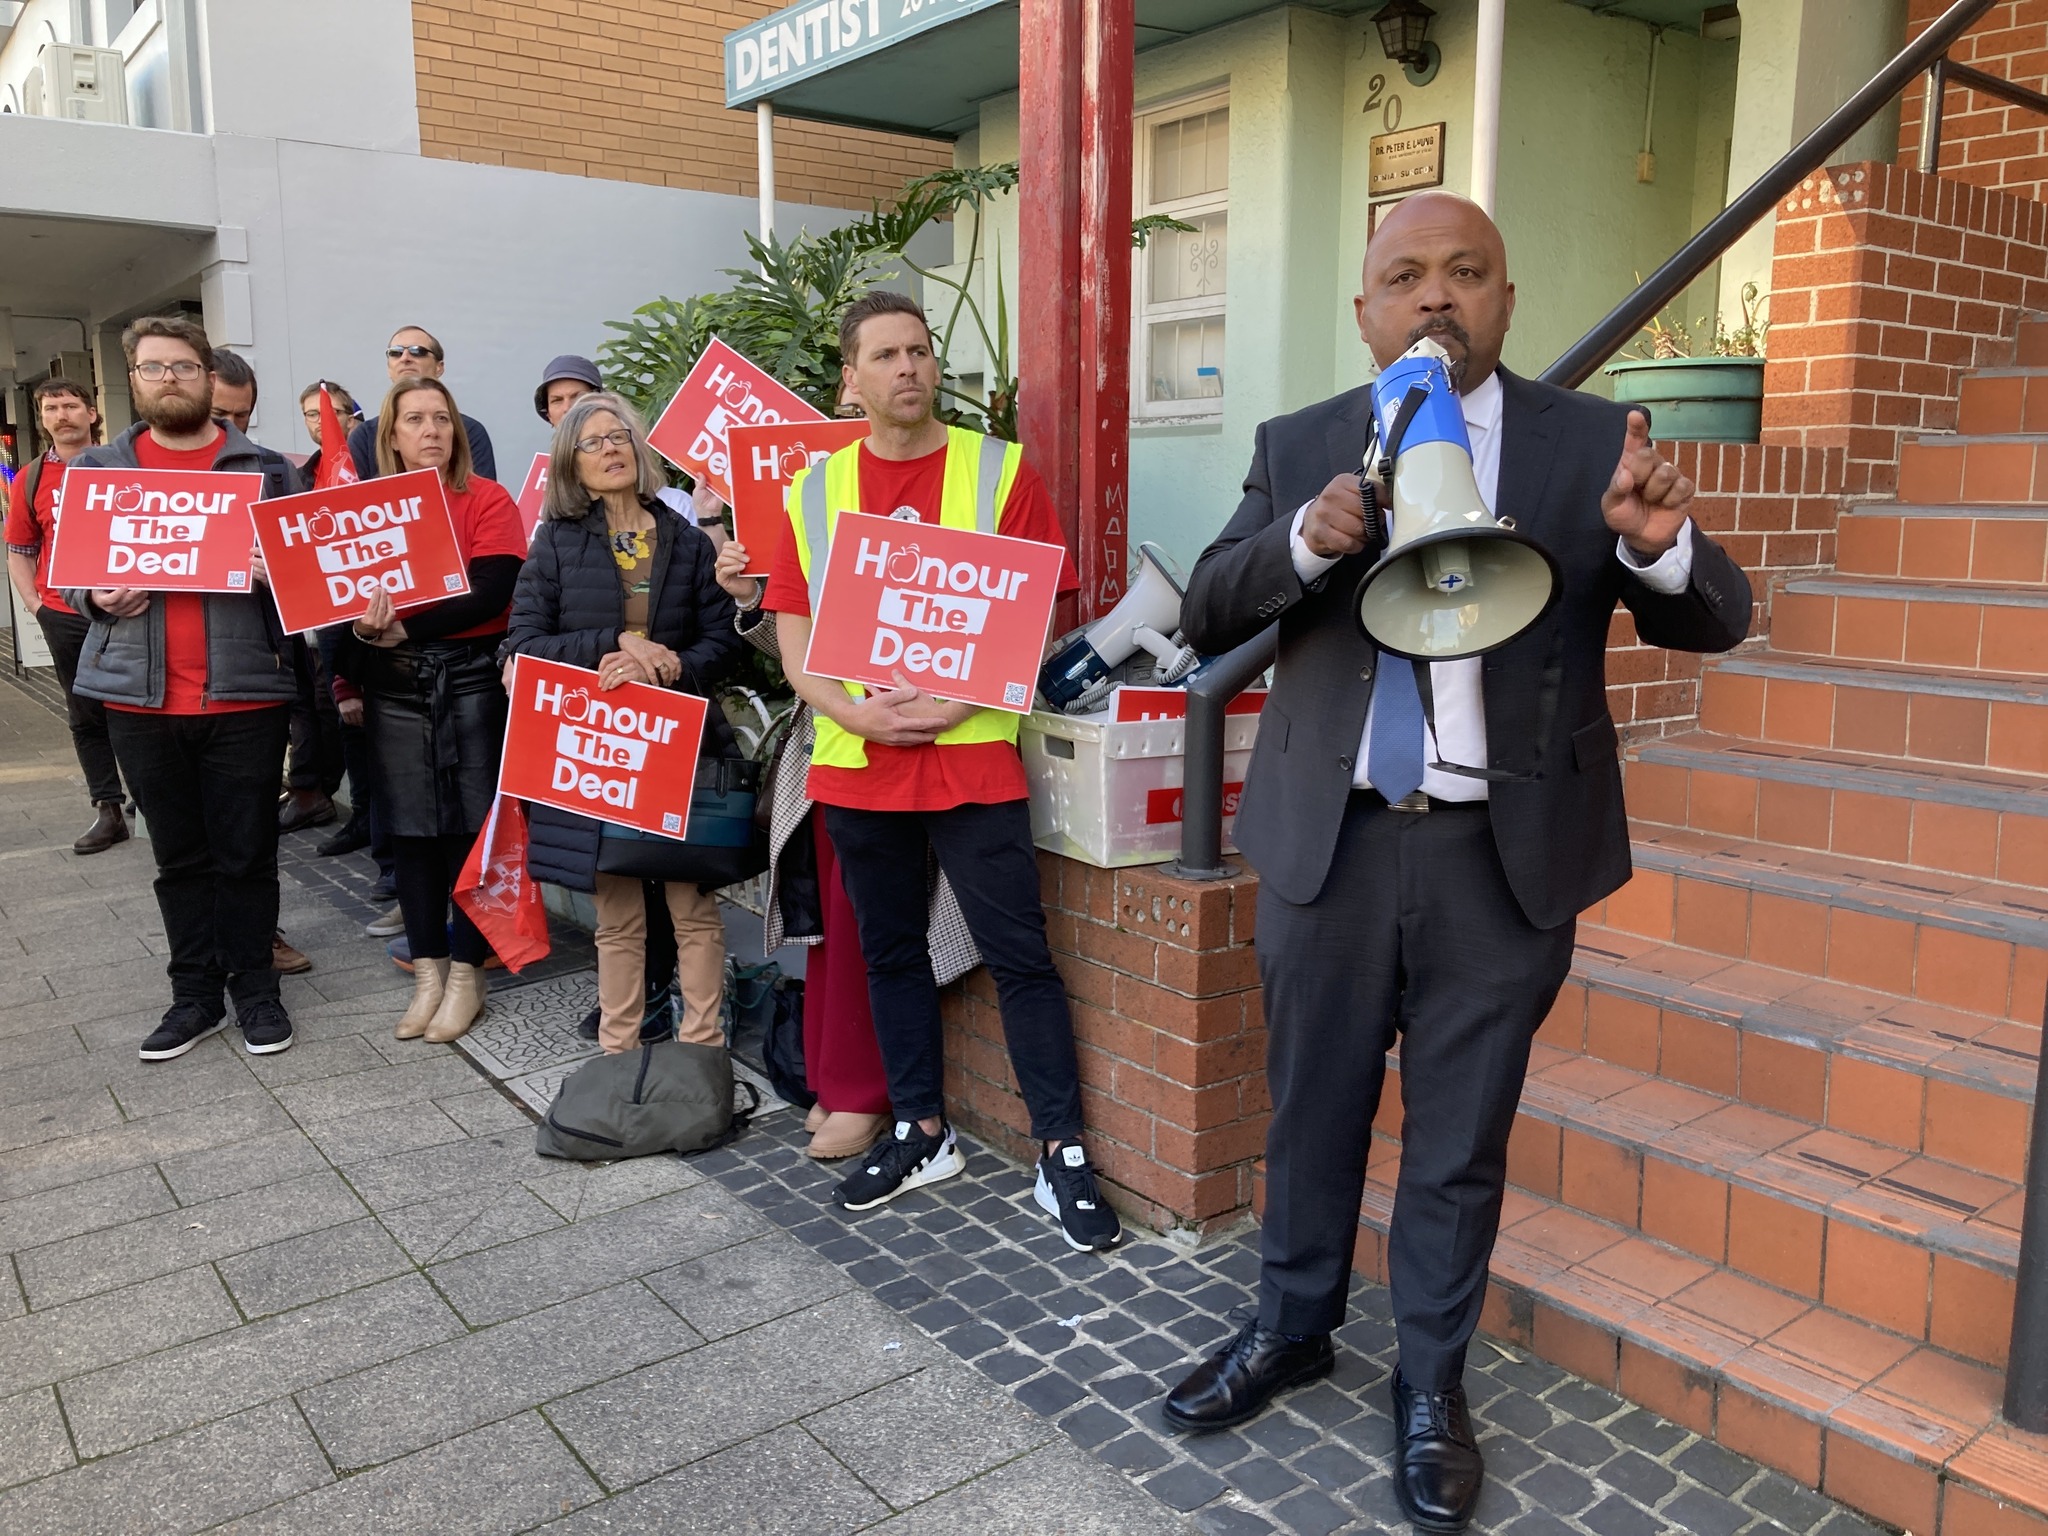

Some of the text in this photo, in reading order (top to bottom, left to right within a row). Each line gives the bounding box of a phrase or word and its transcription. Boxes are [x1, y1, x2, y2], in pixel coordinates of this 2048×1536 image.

[735, 0, 880, 90] DENTIST
[1363, 74, 1402, 132] 20
[1386, 142, 1405, 154] PETER
[704, 363, 790, 424] Hono
[687, 431, 731, 487] De
[85, 483, 236, 514] Honour
[278, 496, 422, 547] Honour
[128, 519, 190, 540] The
[332, 540, 393, 565] The
[107, 545, 199, 575] Deal
[326, 560, 415, 607] Deal
[855, 537, 1029, 601] Honour
[900, 593, 968, 630] The
[869, 627, 976, 681] Deal
[534, 679, 679, 744] Honour
[574, 729, 631, 766] The
[552, 757, 637, 810] Deal
